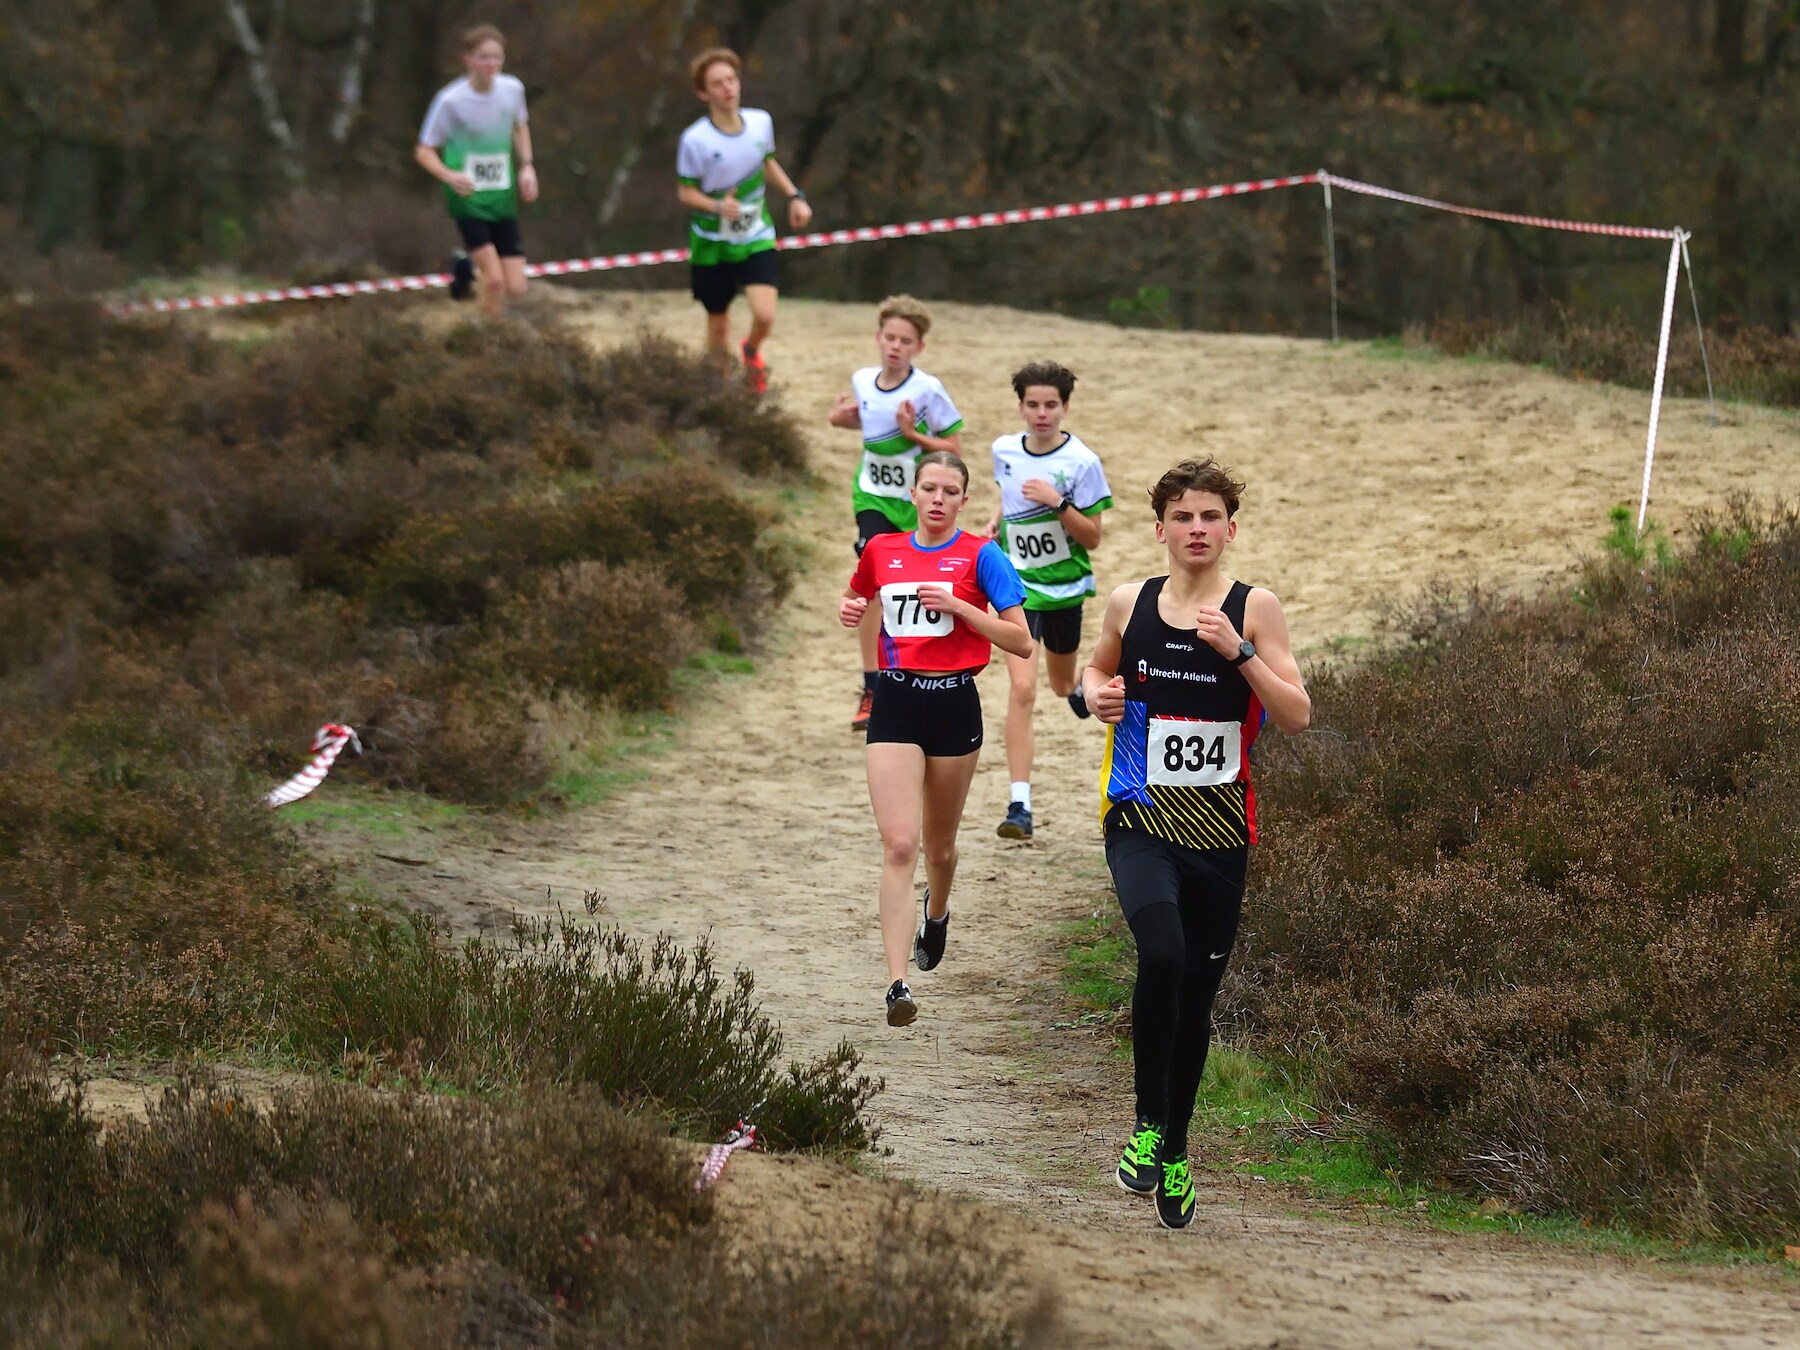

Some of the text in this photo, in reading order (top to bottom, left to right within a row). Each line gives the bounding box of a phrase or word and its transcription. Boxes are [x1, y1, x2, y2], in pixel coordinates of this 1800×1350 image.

[1016, 532, 1057, 559] 906
[1165, 643, 1188, 651] CRAFT
[911, 676, 959, 690] NIKE
[1149, 667, 1217, 684] Utrecht Atletiek
[1163, 735, 1226, 772] 834
